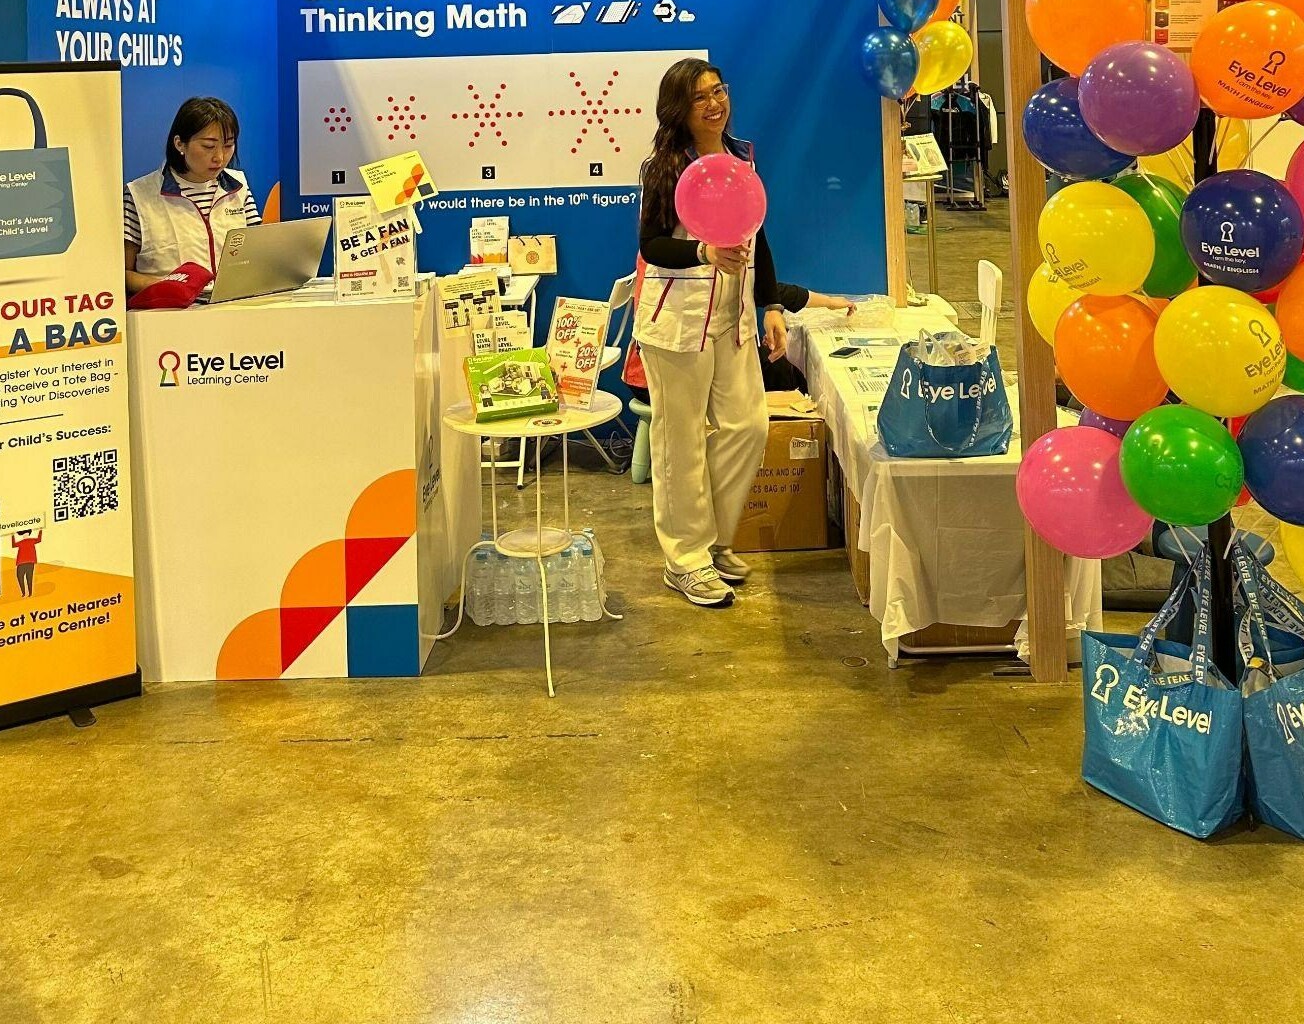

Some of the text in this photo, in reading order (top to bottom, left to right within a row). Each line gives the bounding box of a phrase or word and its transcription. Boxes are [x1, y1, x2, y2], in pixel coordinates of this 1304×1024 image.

[300, 3, 527, 38] Thinking Math
[56, 30, 183, 67] YOUR CHILD'S
[1217, 80, 1240, 96] MATH
[1228, 60, 1292, 98] Eye Level
[8, 171, 36, 181] Level
[302, 191, 637, 214] How would there be in the 10th figure?
[24, 216, 53, 225] Always
[26, 225, 48, 234] Level
[339, 234, 361, 251] BE
[365, 229, 376, 244] A
[378, 218, 410, 239] FAN
[350, 234, 410, 261] & GET A FAN
[1201, 242, 1260, 258] Eye Level
[1226, 266, 1259, 274] ENGLISH
[64, 291, 114, 313] TAG
[557, 315, 581, 328] 100%
[8, 327, 33, 355] A
[45, 317, 118, 350] BAG
[556, 328, 576, 340] OFF
[579, 346, 598, 357] 20%
[33, 365, 58, 376] Your
[61, 360, 102, 373] Interest
[104, 358, 114, 367] in
[187, 350, 284, 376] Eye Level
[576, 357, 595, 369] OFF
[1244, 355, 1271, 378] Eye
[4, 380, 49, 393] Receive
[52, 378, 60, 387] a
[63, 374, 87, 386] Tote
[90, 371, 111, 384] Bag
[187, 373, 269, 386] Learning Center
[20, 392, 46, 404] Your
[48, 384, 110, 401] Discoveries
[7, 432, 53, 449] Child's
[55, 424, 111, 441] Success:
[776, 468, 790, 476] AND
[792, 467, 805, 476] CUP
[764, 485, 778, 493] BAG
[748, 501, 768, 510] CHINA
[1237, 555, 1252, 584] LEVEL
[9, 614, 26, 628] at
[29, 606, 63, 623] Your
[67, 592, 123, 615] Nearest
[1198, 588, 1210, 636] EYE LEVEL
[1247, 592, 1260, 611] EYE
[57, 611, 111, 634] Centre!
[1140, 607, 1168, 652] EYE LEVEL
[1195, 643, 1206, 685] EYE LEV
[1122, 684, 1213, 735] Eye Level
